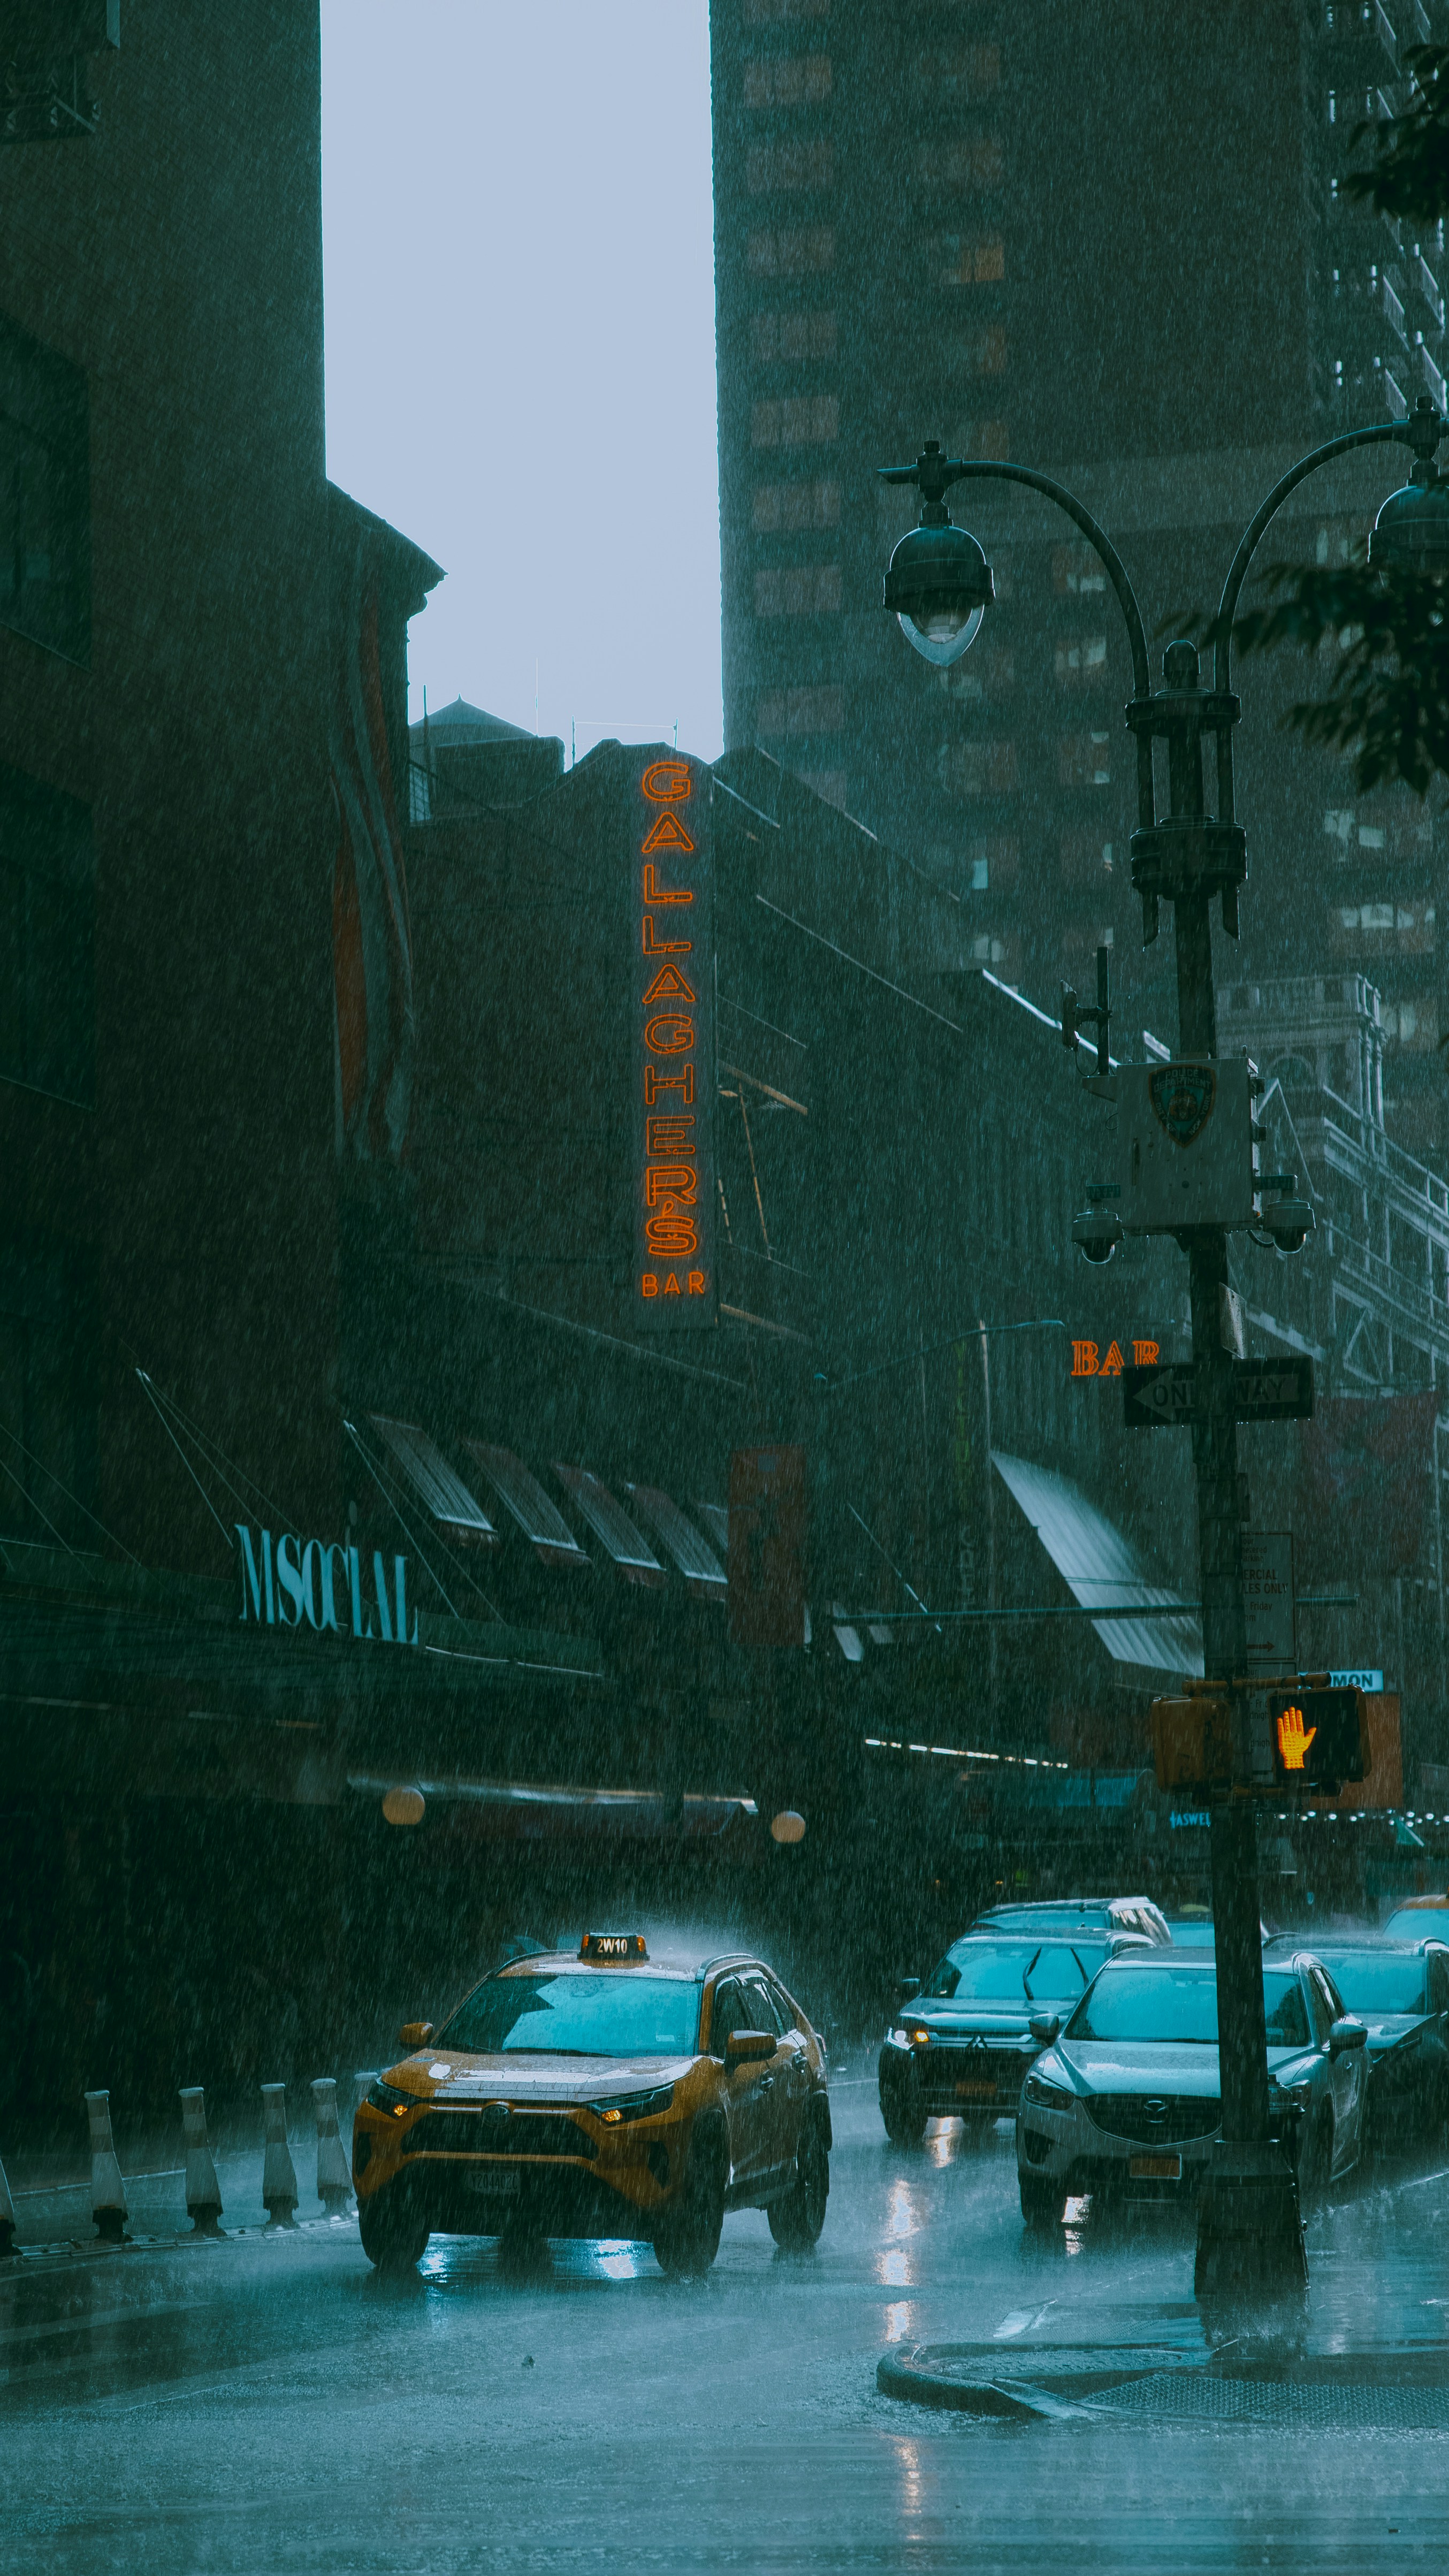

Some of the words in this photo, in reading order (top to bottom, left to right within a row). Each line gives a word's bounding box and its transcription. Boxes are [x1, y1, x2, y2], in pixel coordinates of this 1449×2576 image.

[1165, 1069, 1199, 1079] POLICE
[1154, 1077, 1211, 1092] DEPARTMENT
[1155, 1102, 1169, 1119] CITY
[1200, 1094, 1212, 1116] YORK
[642, 1271, 705, 1298] BAR
[1071, 1340, 1160, 1376] BAR
[1152, 1381, 1193, 1407] ON
[1243, 1554, 1264, 1563] arking
[1264, 1583, 1288, 1594] ONLY
[1250, 1601, 1272, 1612] Friday
[597, 1938, 628, 1954] 2W10
